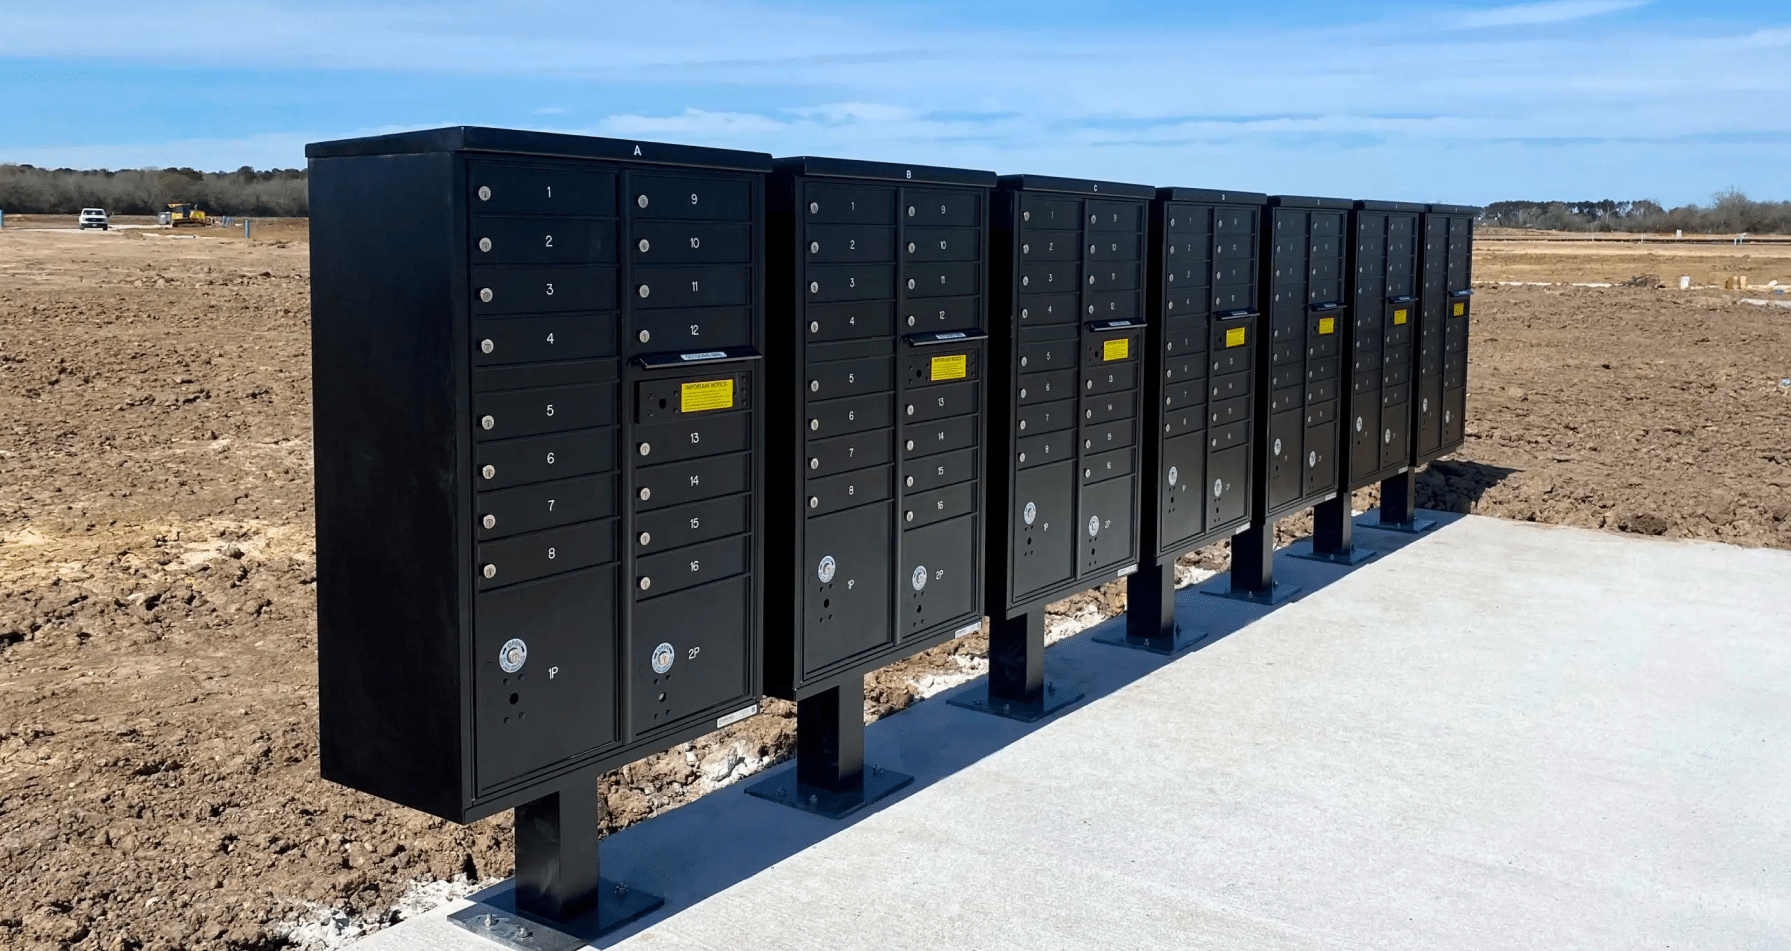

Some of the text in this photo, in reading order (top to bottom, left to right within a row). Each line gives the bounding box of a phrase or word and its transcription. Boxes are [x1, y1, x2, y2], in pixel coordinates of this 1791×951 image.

[633, 144, 642, 156] A
[906, 169, 912, 179] B
[546, 185, 552, 198] 1
[690, 193, 698, 205] 9
[850, 201, 855, 211] 1
[940, 204, 946, 215] 9
[545, 234, 553, 248] 2
[689, 237, 700, 249] 10
[849, 239, 856, 250] 2
[939, 240, 947, 250] 10
[691, 280, 699, 292] 11
[849, 277, 855, 288] 3
[546, 283, 554, 296] 3
[849, 316, 855, 326] 4
[939, 310, 946, 320] 12
[689, 324, 700, 336] 12
[546, 332, 555, 345] 4
[848, 373, 855, 384] 5
[938, 397, 945, 407] 13
[546, 404, 555, 417] 5
[848, 410, 855, 421] 6
[690, 432, 700, 444] 13
[546, 452, 555, 465] 6
[848, 447, 854, 458] 7
[689, 474, 700, 487] 14
[848, 485, 854, 496] 8
[547, 499, 555, 512] 7
[690, 517, 700, 529] 15
[548, 547, 556, 560] 8
[689, 560, 699, 572] 16
[507, 640, 522, 648] OPEN
[688, 646, 701, 660] 2P
[548, 666, 559, 680] 1P
